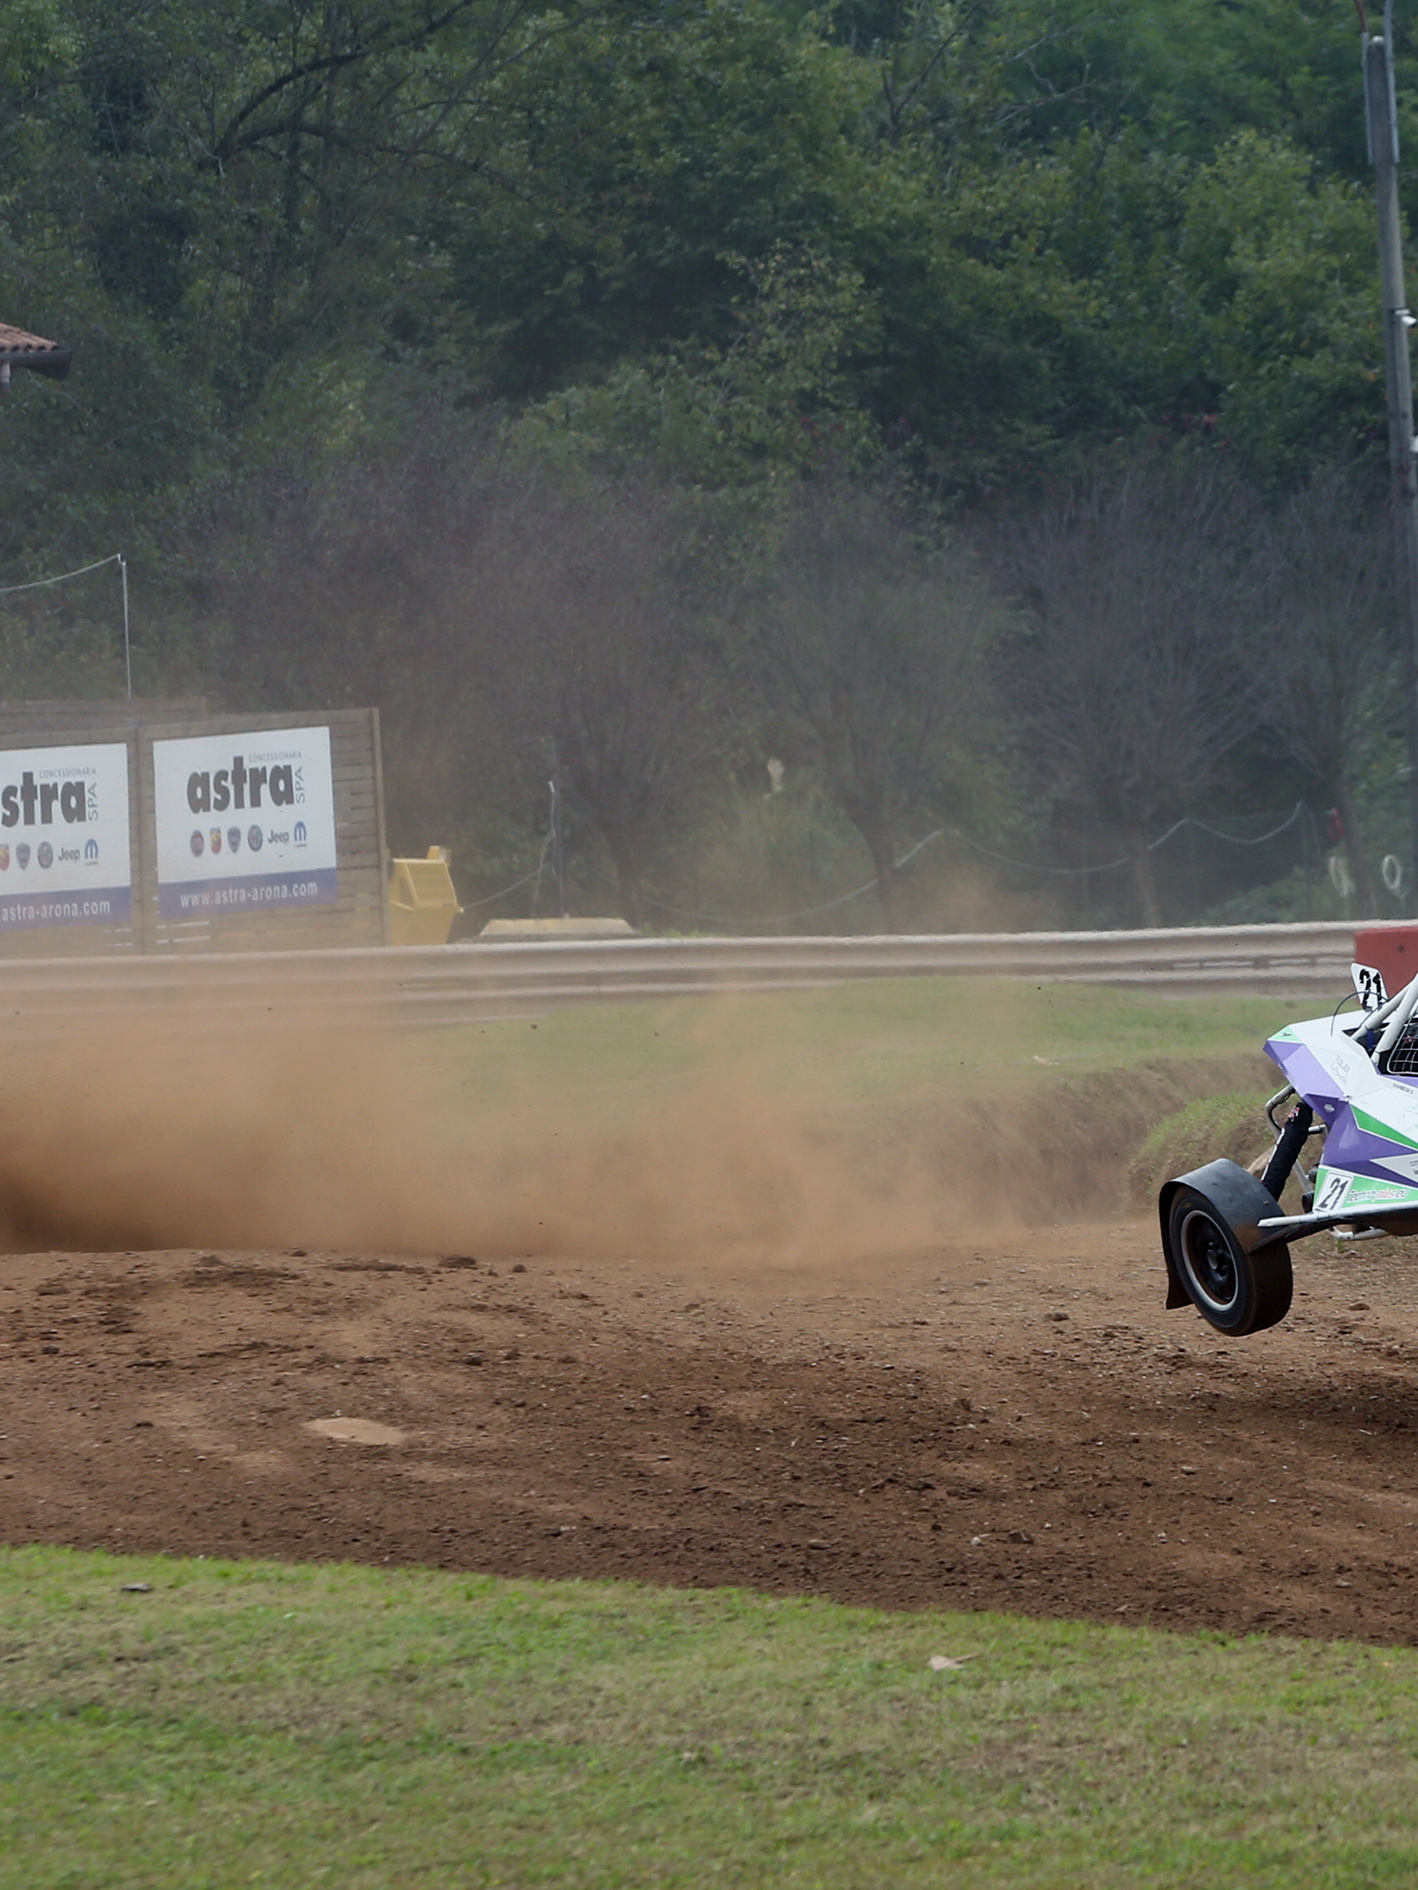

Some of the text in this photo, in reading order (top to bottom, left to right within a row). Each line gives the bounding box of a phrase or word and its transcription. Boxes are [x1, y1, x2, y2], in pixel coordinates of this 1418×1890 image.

[39, 766, 97, 779] CONCESSIONARIA
[187, 755, 295, 814] astra
[294, 766, 305, 804] SPA
[87, 782, 98, 821] SPA
[267, 830, 289, 845] Jeep
[58, 847, 80, 863] Jeep
[180, 881, 318, 908] www.astra-arona.com
[1359, 968, 1383, 1013] 21
[1318, 1177, 1349, 1210] 21
